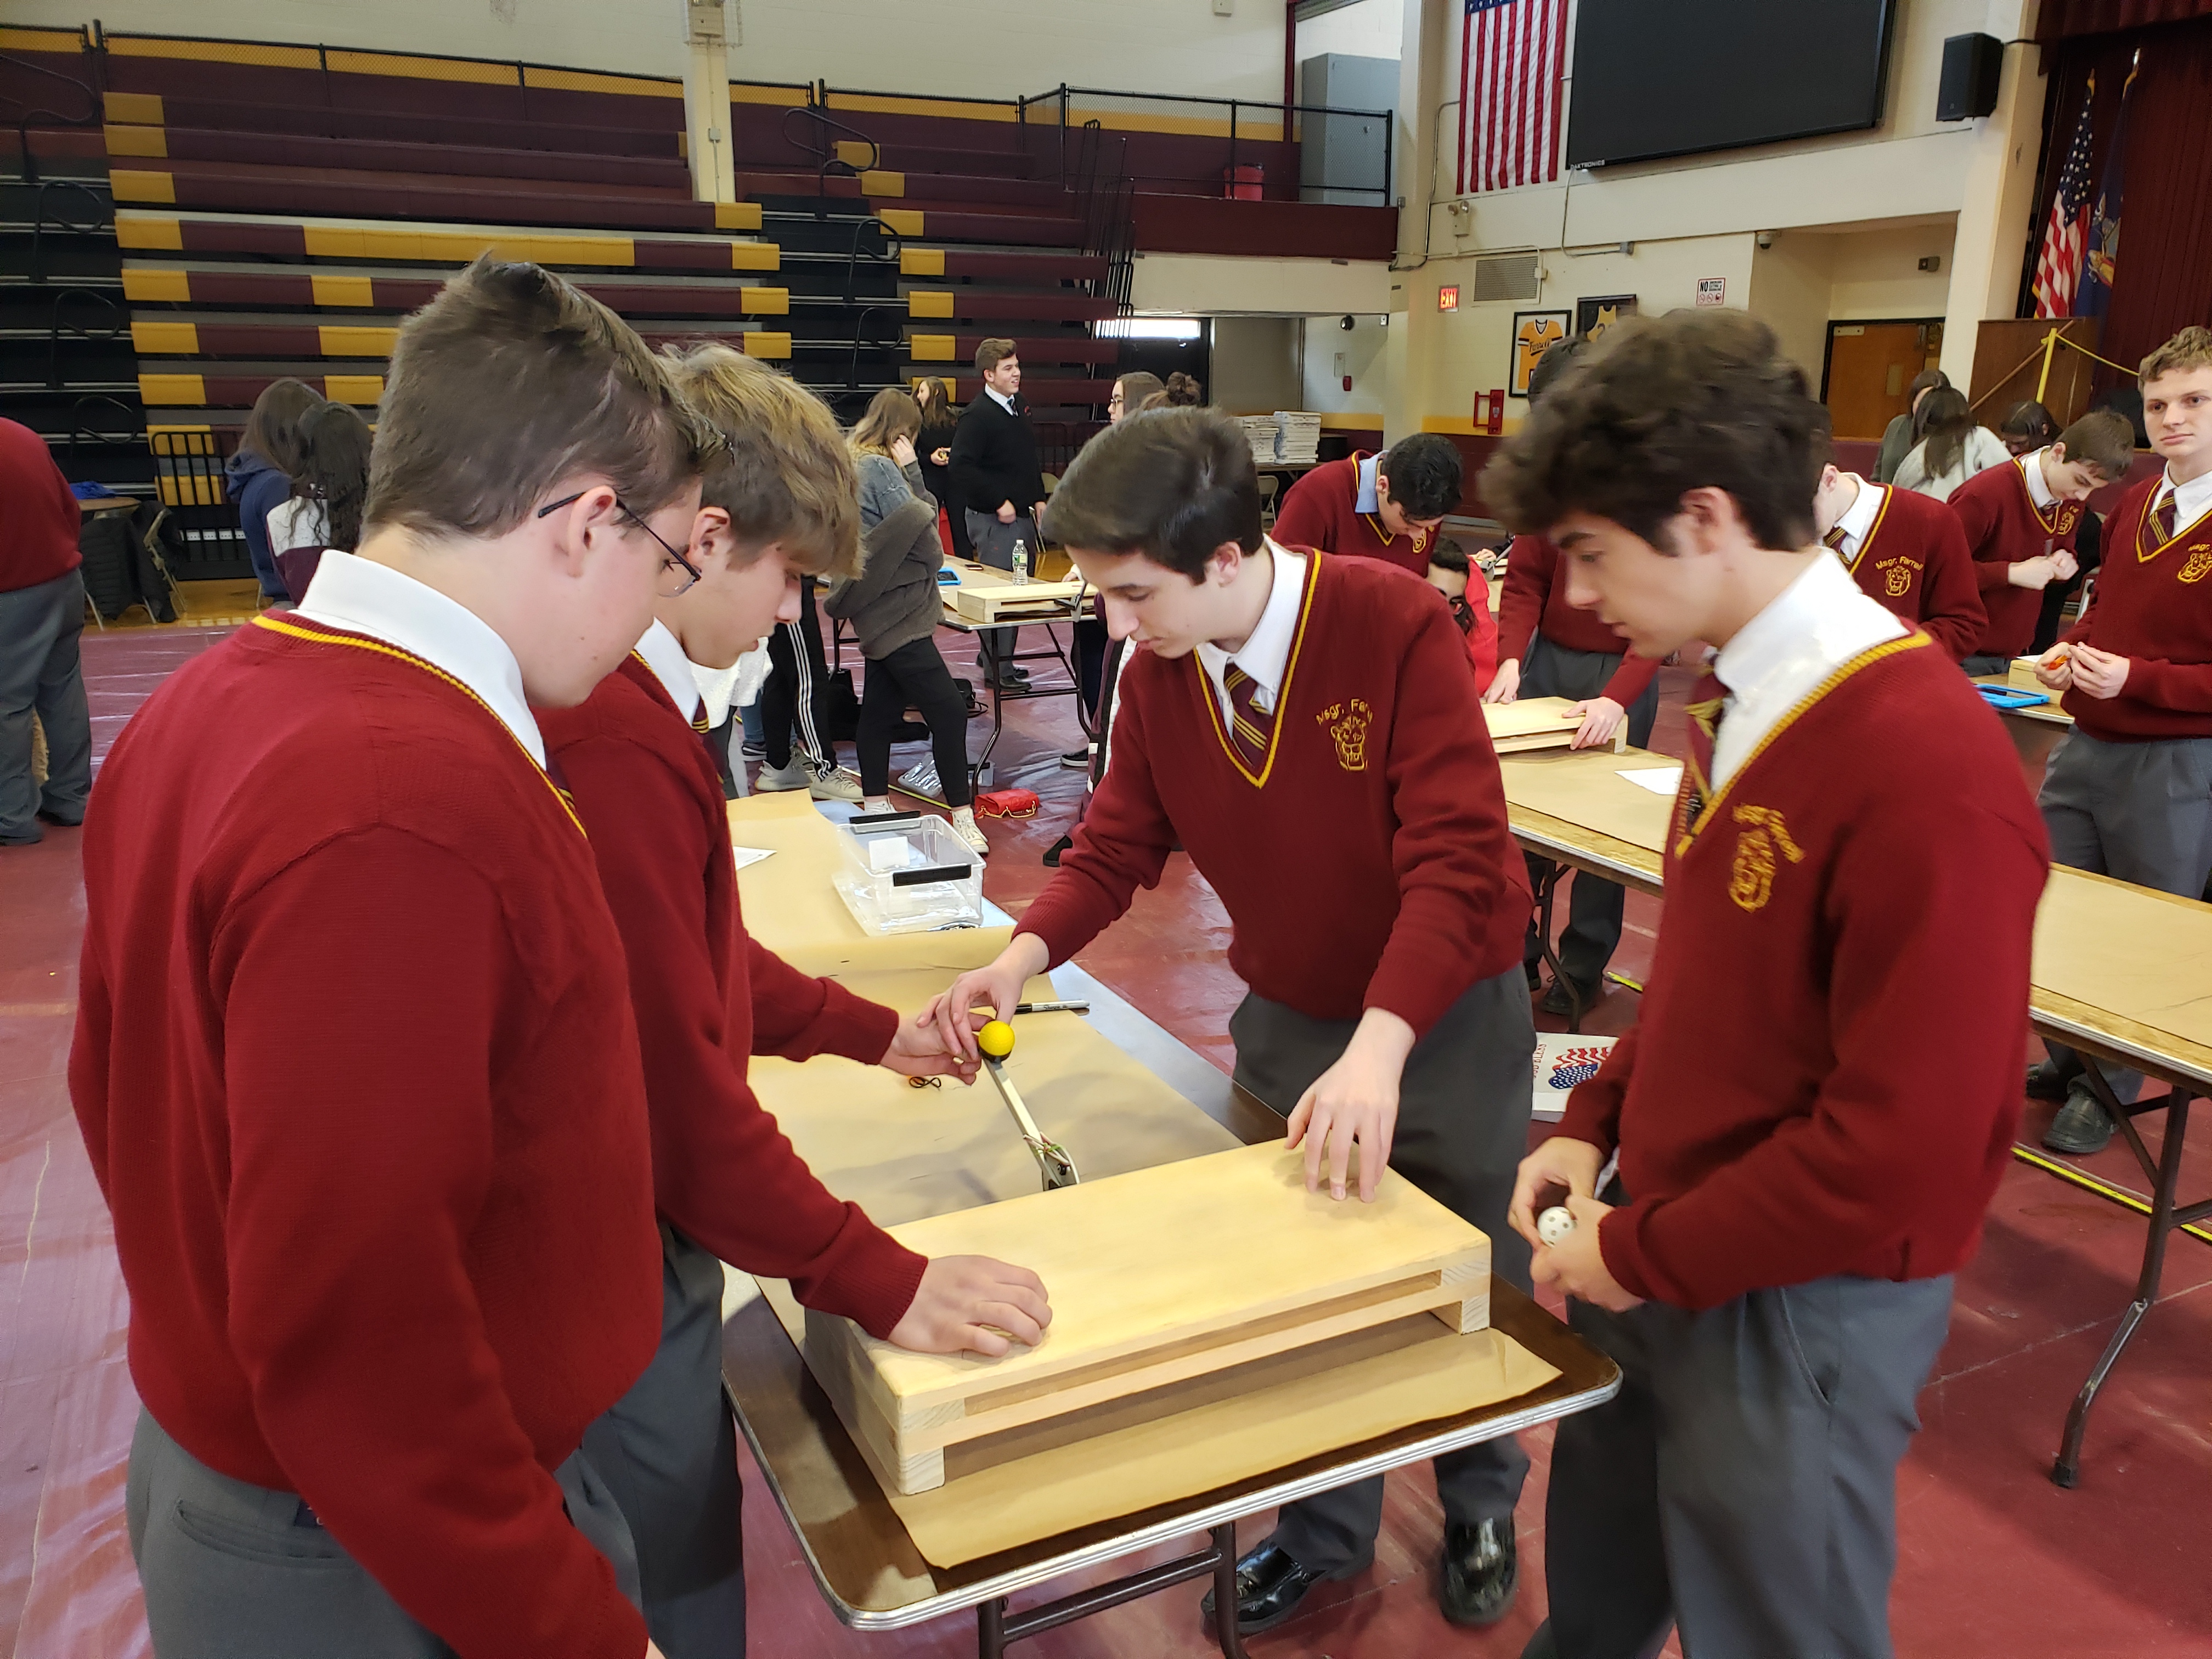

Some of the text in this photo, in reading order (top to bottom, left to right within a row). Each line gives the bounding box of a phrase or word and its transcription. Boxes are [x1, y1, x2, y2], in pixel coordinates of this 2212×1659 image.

[1700, 281, 1708, 292] NO
[1440, 289, 1457, 308] EXIT
[1876, 556, 1923, 571] Msgr. Farrell
